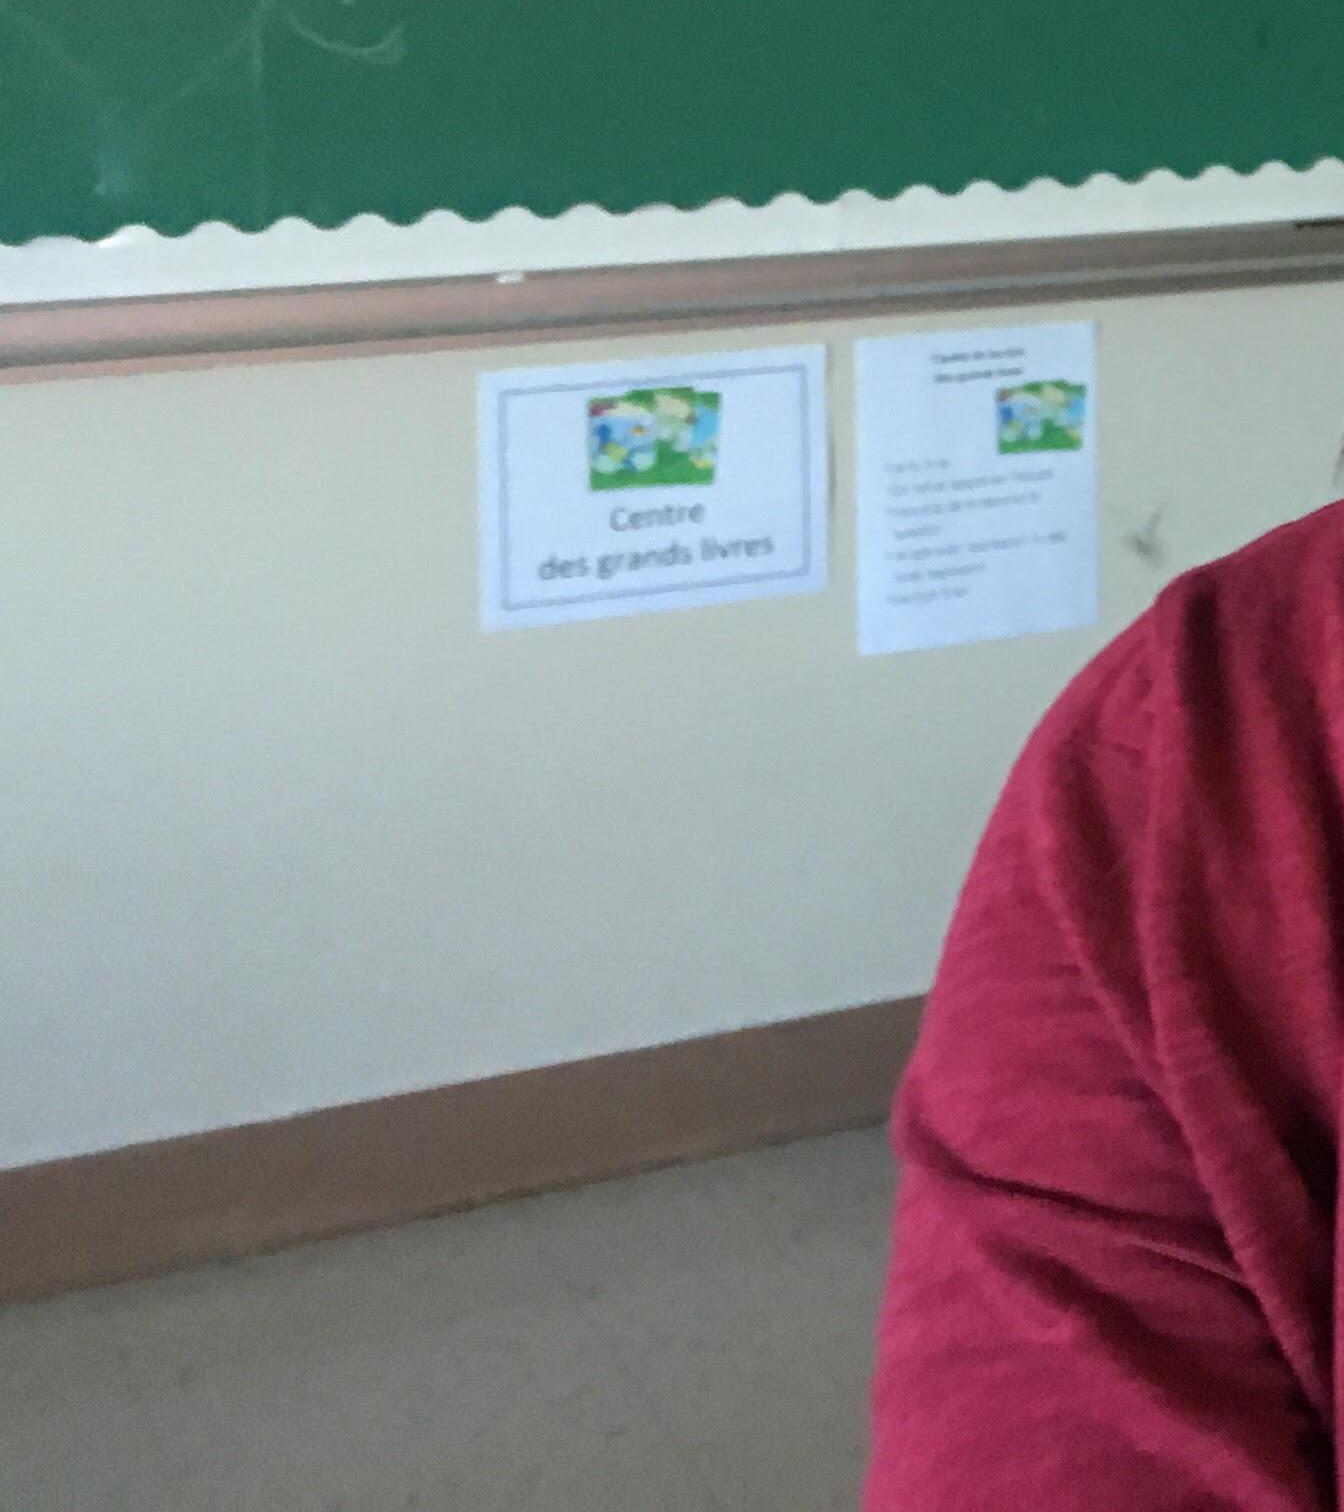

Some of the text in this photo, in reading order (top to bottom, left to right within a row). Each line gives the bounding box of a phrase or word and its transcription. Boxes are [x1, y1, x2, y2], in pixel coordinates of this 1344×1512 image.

[610, 503, 705, 532] Centre
[538, 538, 775, 582] des grands livres
